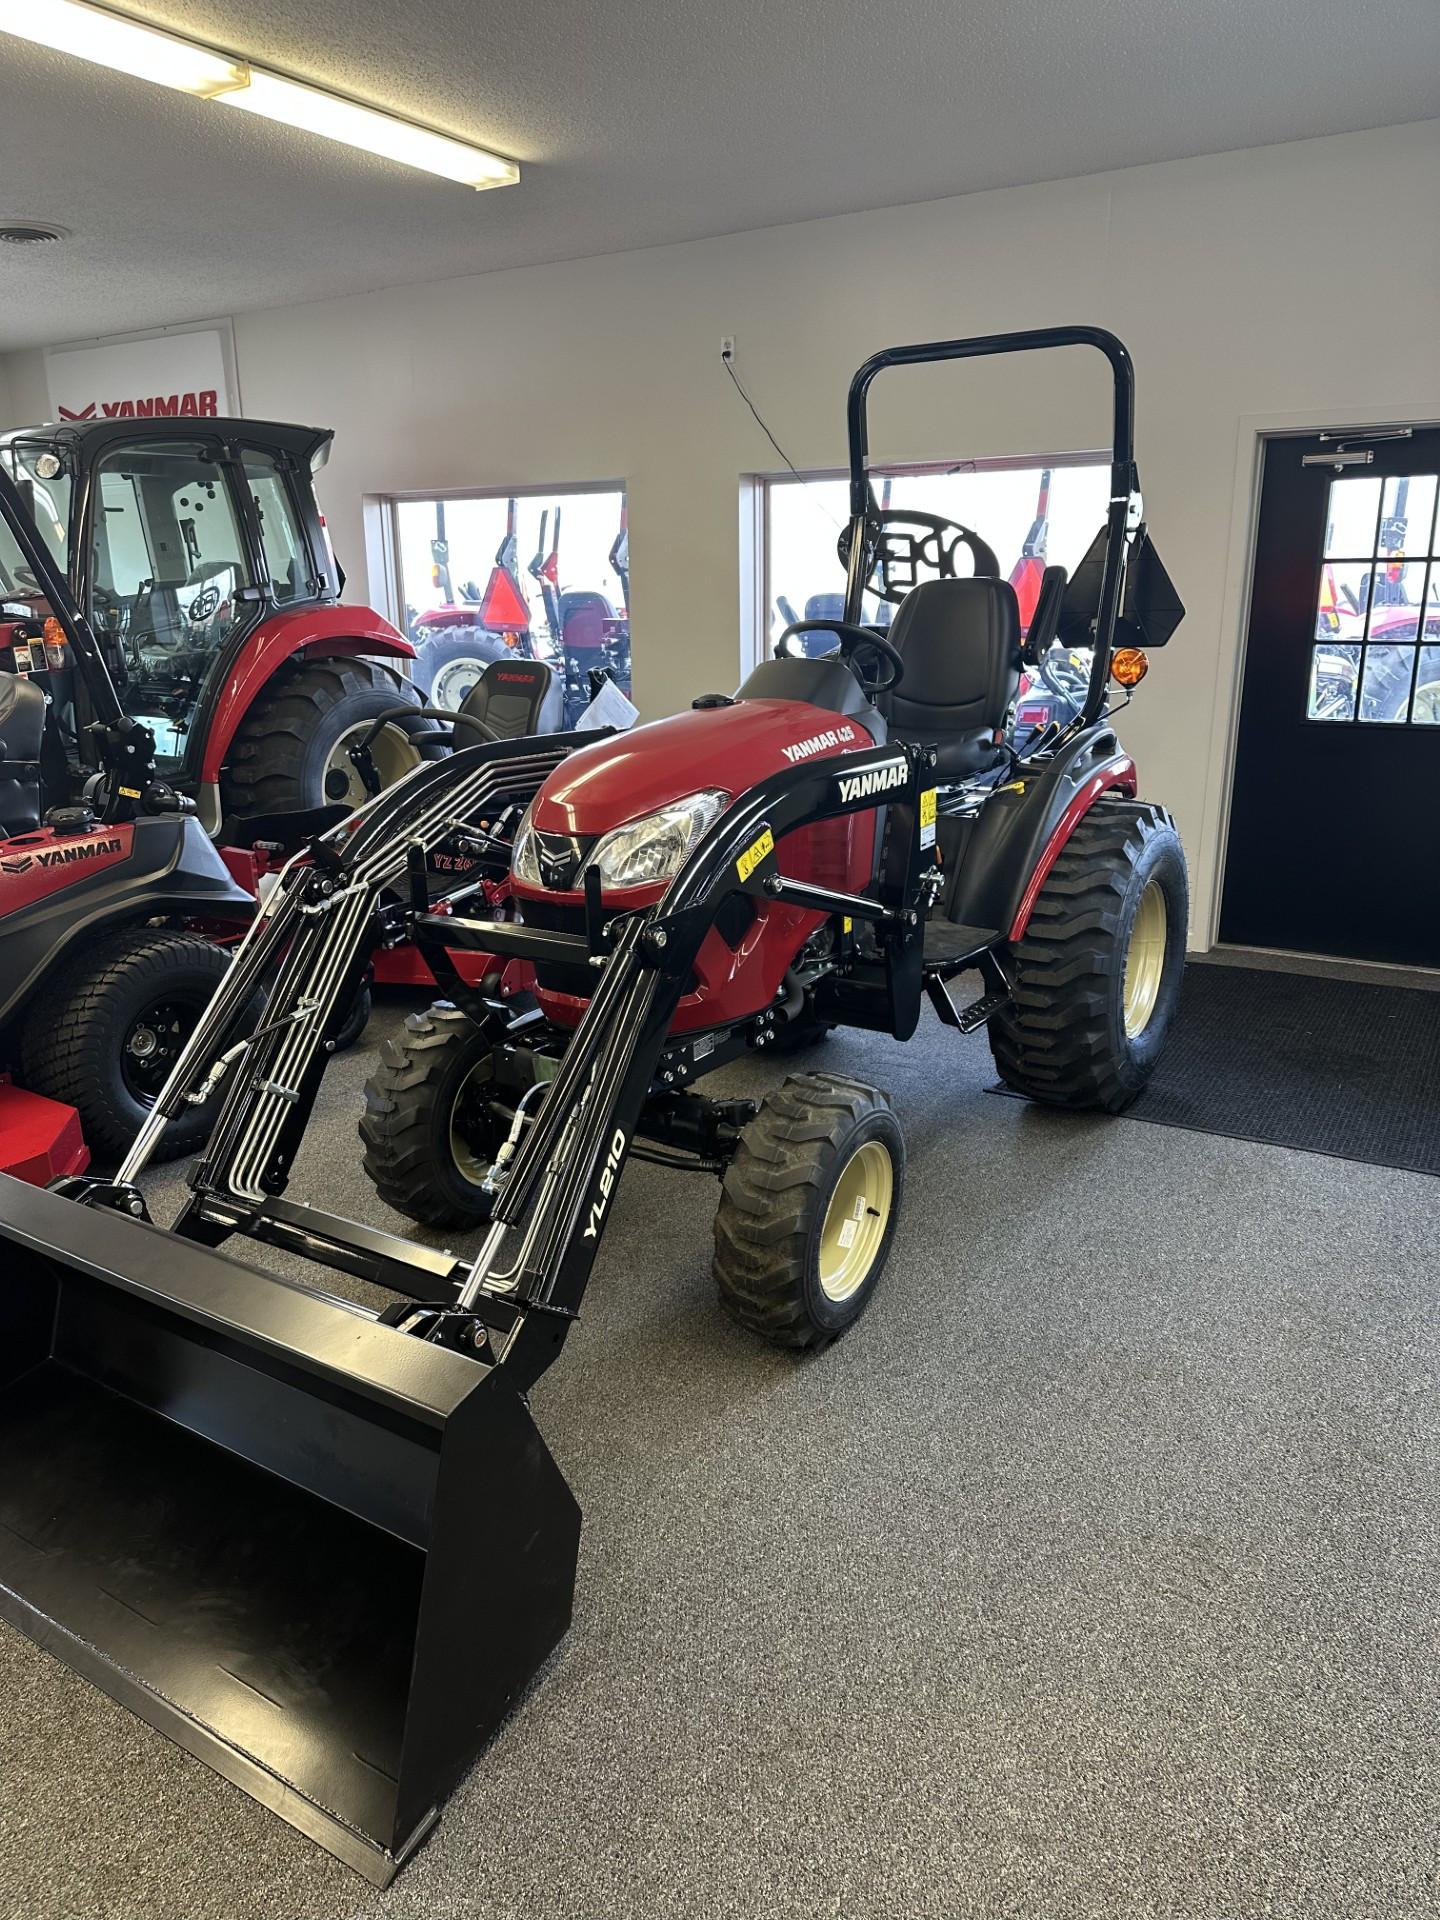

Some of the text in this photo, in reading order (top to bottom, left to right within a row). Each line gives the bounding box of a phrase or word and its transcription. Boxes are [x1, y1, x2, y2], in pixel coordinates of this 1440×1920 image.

[496, 672, 535, 683] YANMAR
[781, 725, 855, 763] YANMAR 425
[838, 764, 909, 803] YANMAR
[36, 839, 121, 867] YANMAR
[433, 853, 477, 870] YZ 26
[583, 1128, 626, 1238] YL210
